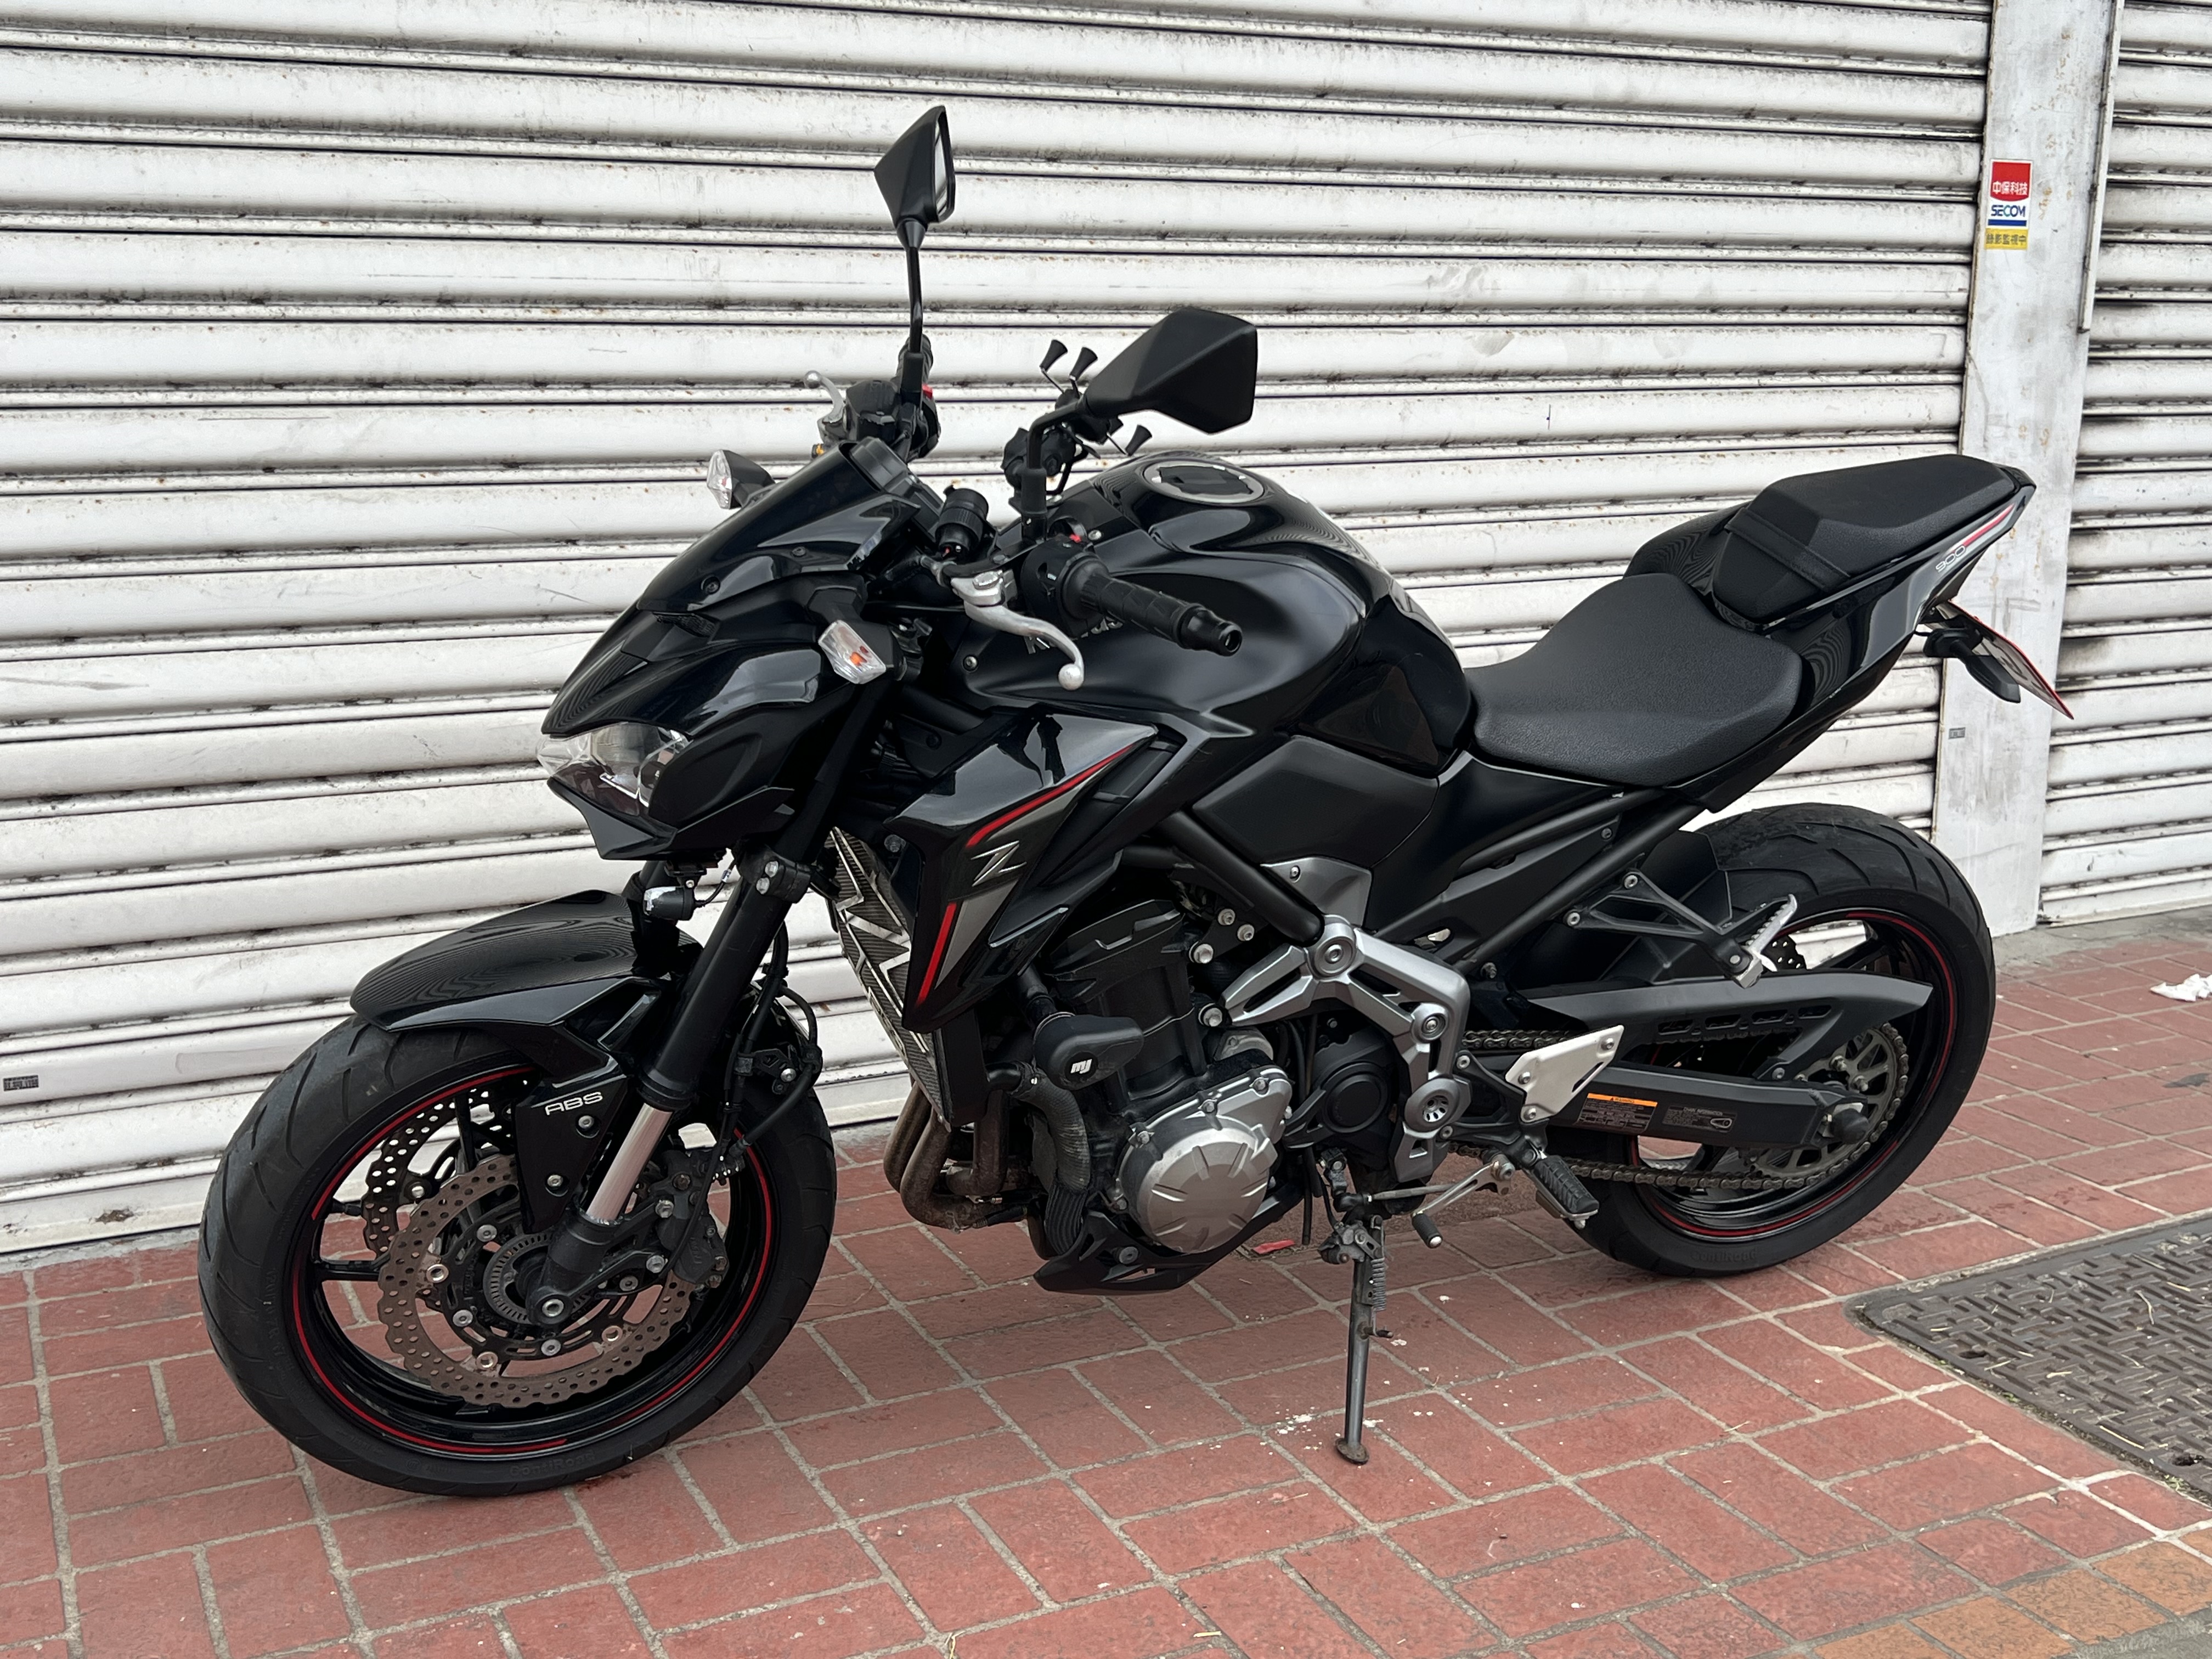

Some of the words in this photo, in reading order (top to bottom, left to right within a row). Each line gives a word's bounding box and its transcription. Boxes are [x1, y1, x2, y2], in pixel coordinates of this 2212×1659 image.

[1993, 181, 2028, 196] 中保科技
[1991, 205, 2026, 217] SECOM
[1936, 545, 1966, 573] 900
[970, 840, 1027, 887] Z
[545, 1091, 603, 1116] ABS
